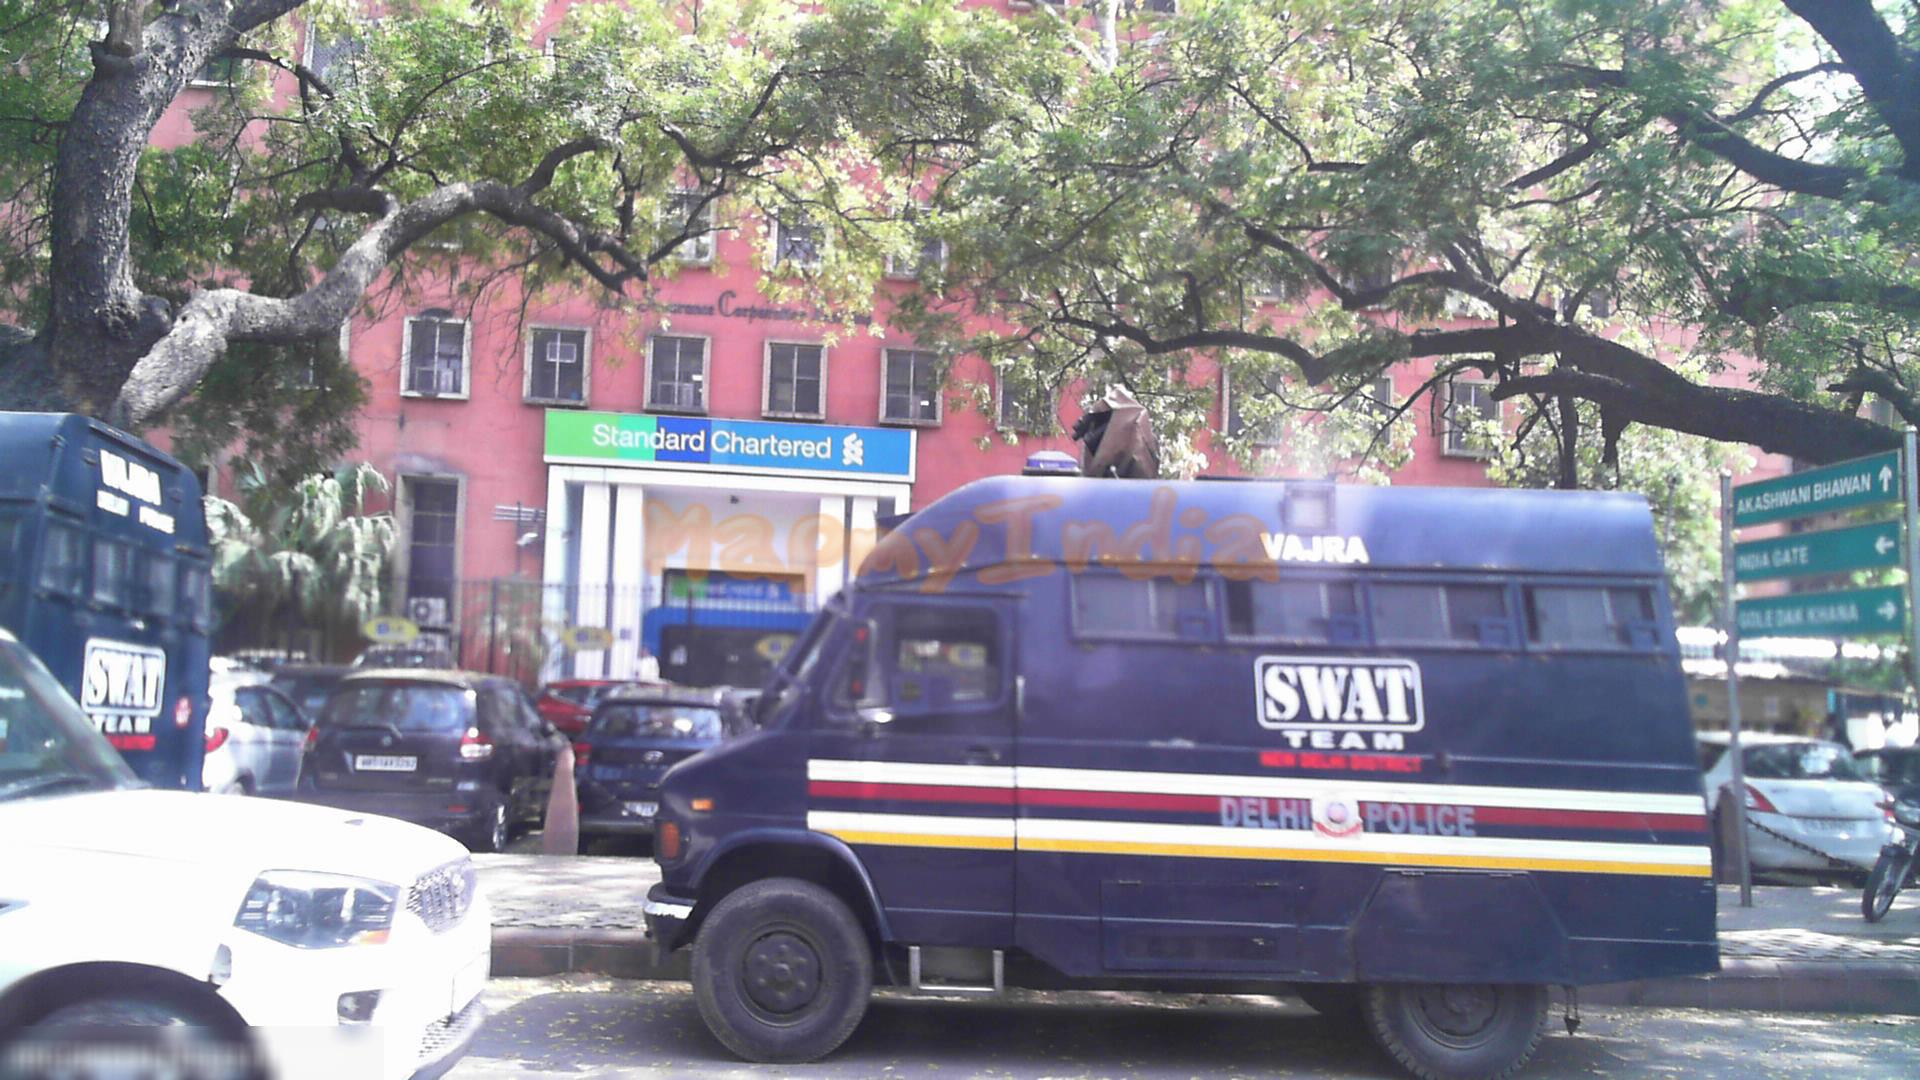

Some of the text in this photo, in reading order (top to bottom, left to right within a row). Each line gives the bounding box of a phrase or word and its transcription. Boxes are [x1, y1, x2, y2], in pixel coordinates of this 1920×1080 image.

[592, 424, 832, 460] Standard Chartered
[1737, 473, 1872, 515] AKASHWANI BHAWAN
[1260, 532, 1370, 564] VAJRA
[1737, 546, 1809, 571] INDIA GATE
[86, 649, 161, 709] SWAT
[1263, 664, 1415, 723] SWAT
[1282, 729, 1405, 751] TEAM
[1219, 796, 1478, 837] DELHI POLICE
